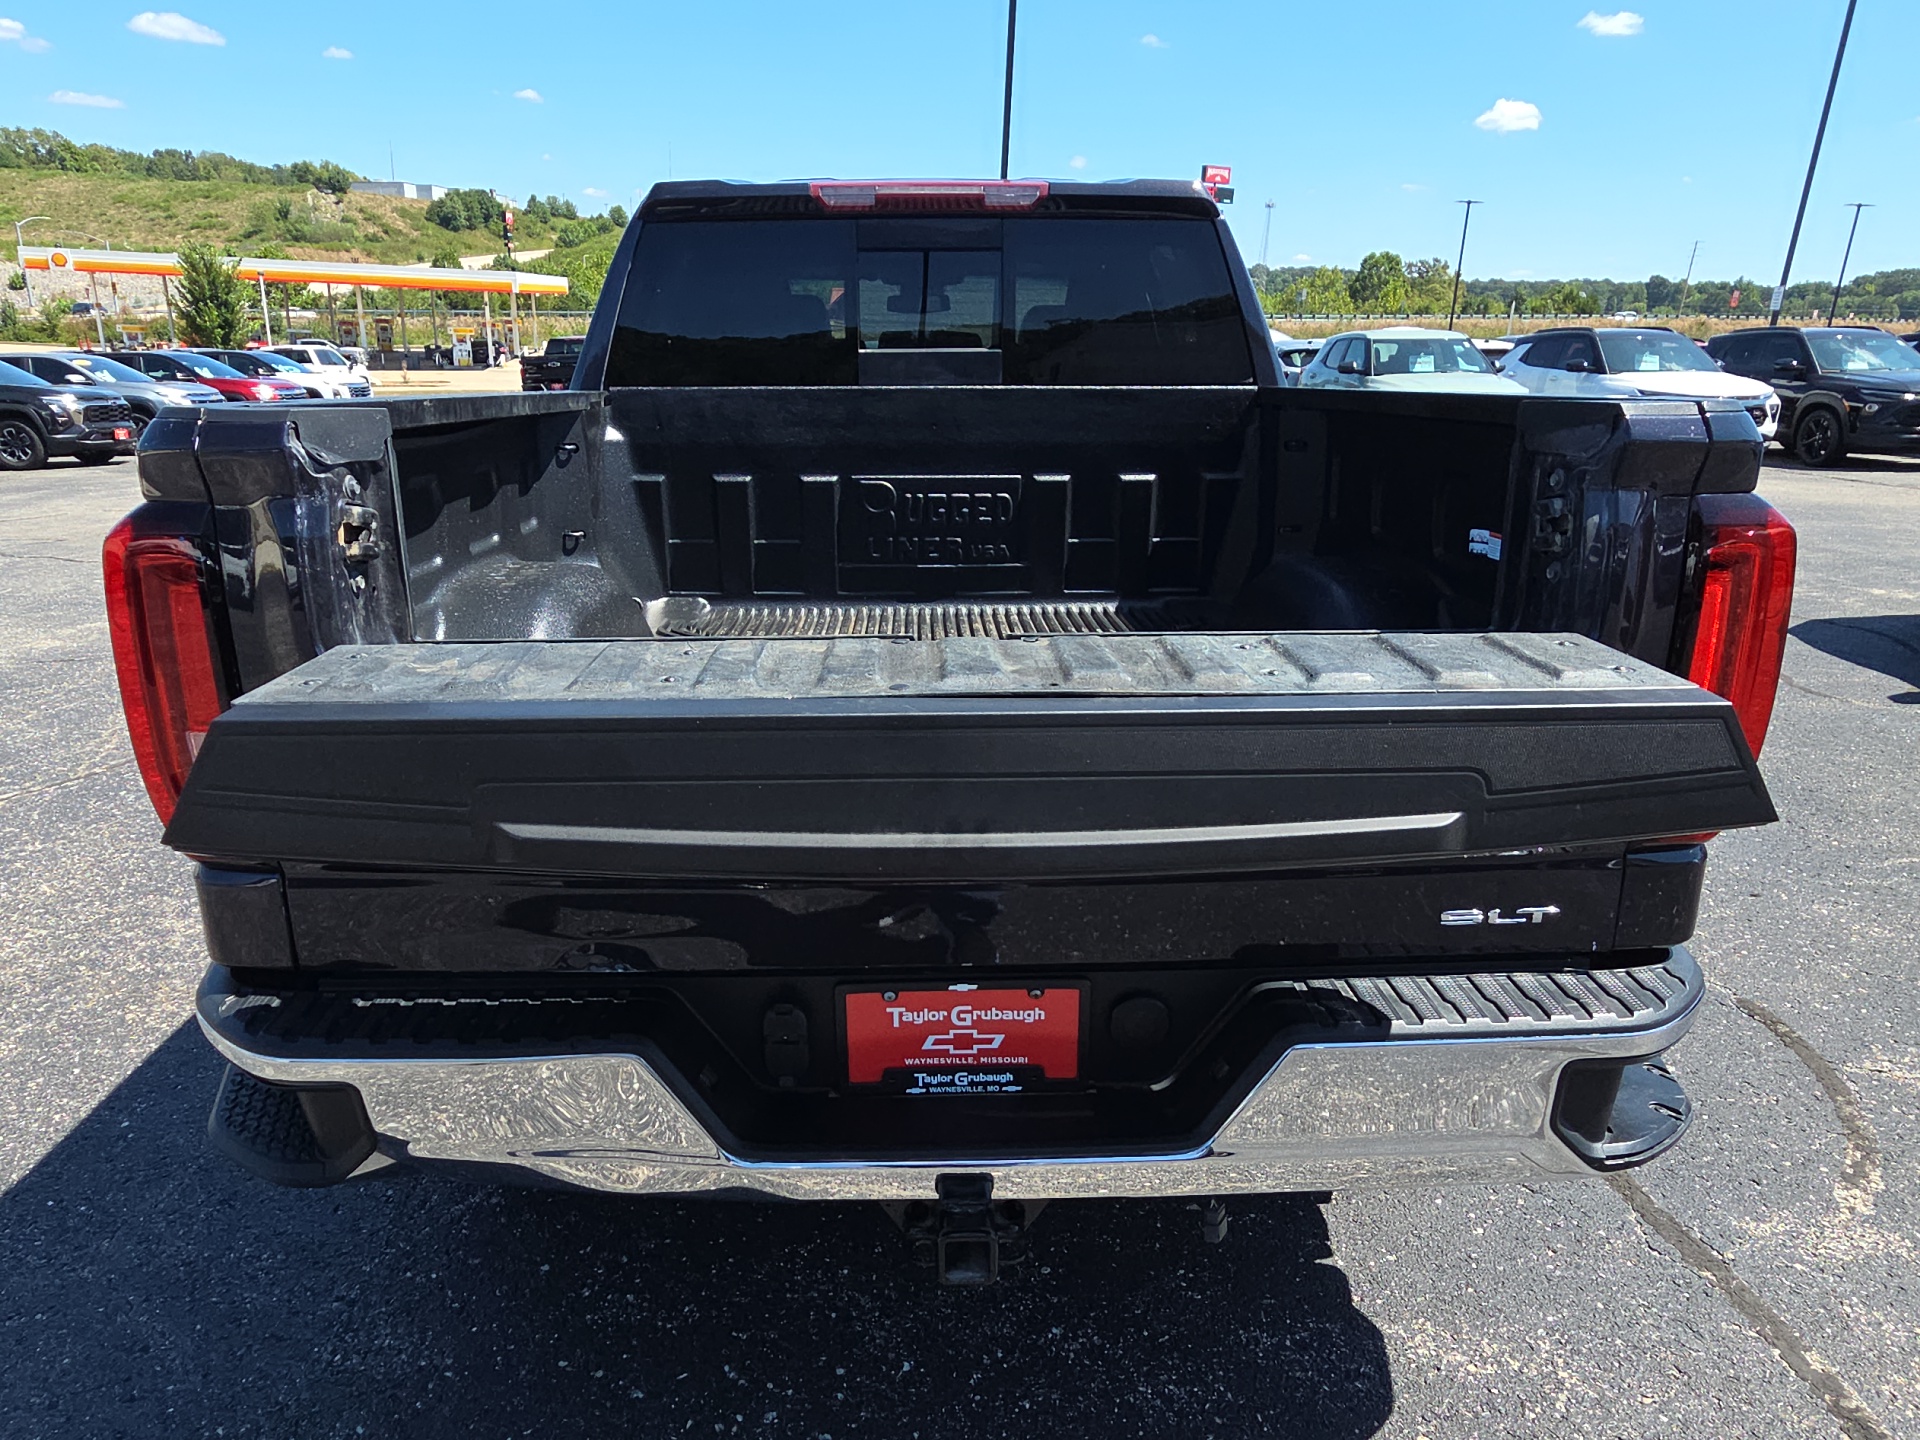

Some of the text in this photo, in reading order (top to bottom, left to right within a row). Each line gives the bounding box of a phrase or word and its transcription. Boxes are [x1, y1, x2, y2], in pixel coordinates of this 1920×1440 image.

[858, 478, 1014, 532] RUGGED
[867, 537, 1011, 559] LINER USA
[1440, 905, 1560, 926] SLT
[886, 1005, 1045, 1028] Taylor Grubaugh
[904, 1056, 1028, 1065] WAYNESVILLE, MISSOURI
[914, 1072, 1013, 1087] Taylor Grubaugh
